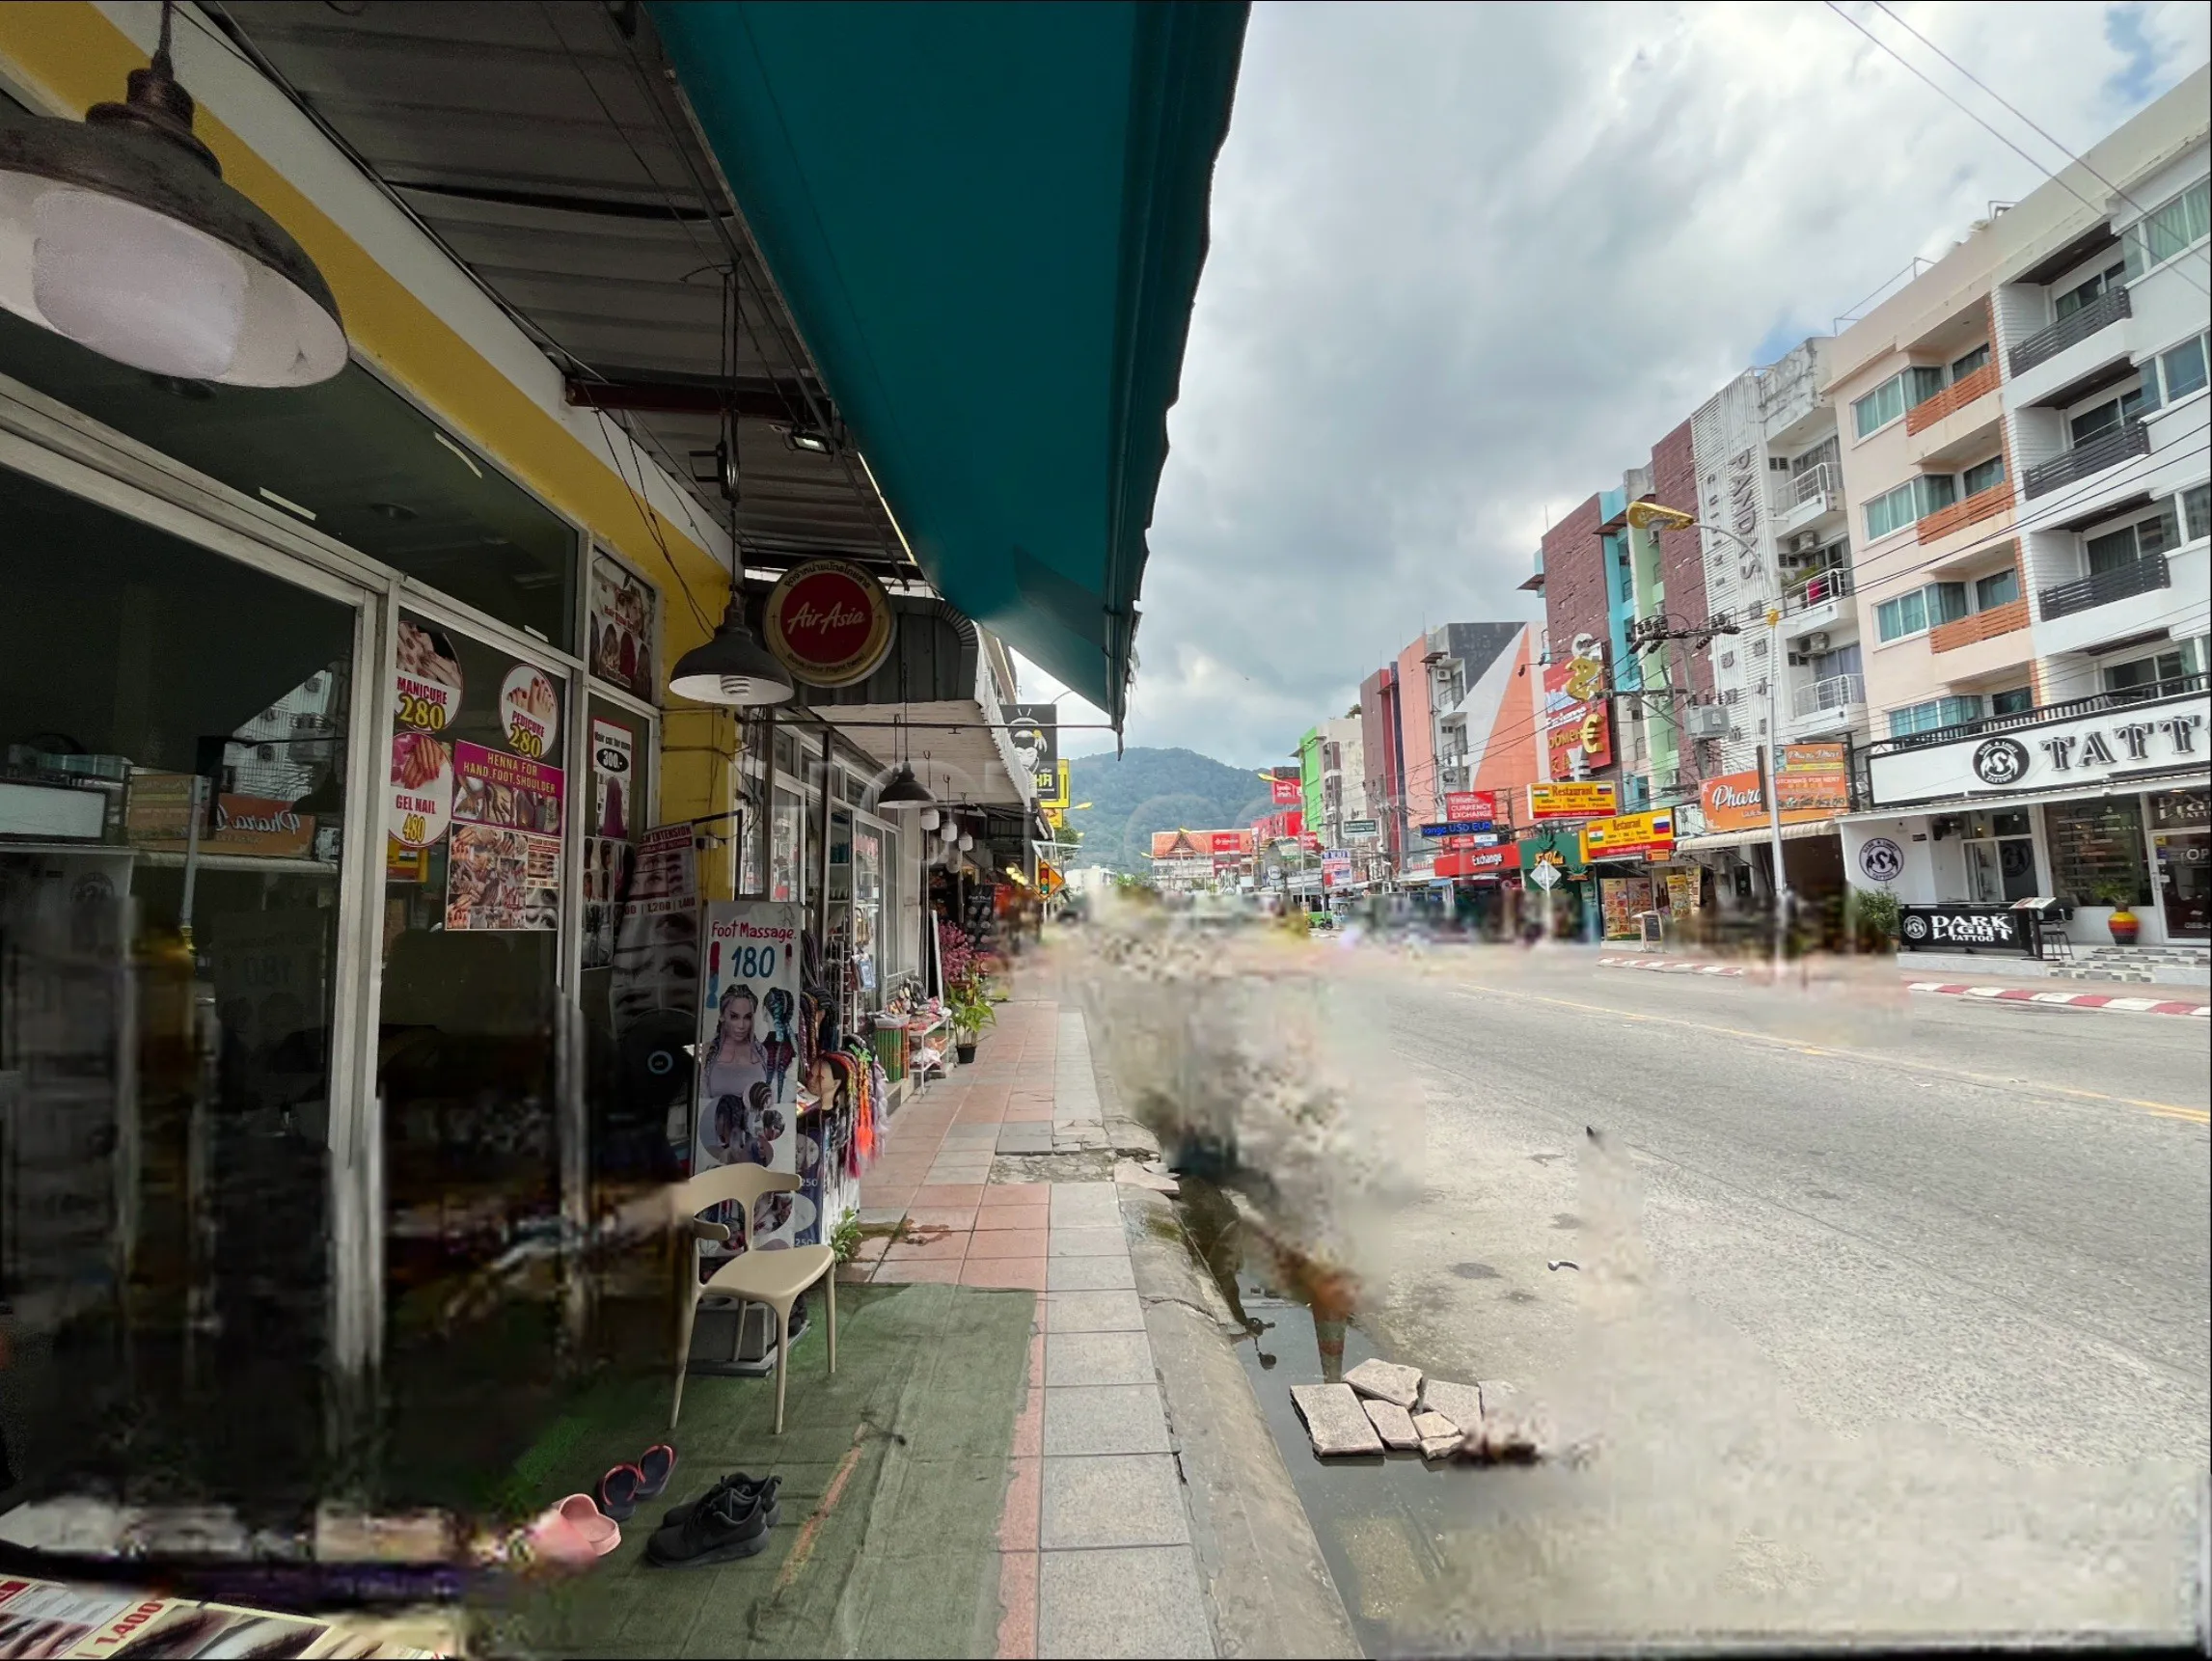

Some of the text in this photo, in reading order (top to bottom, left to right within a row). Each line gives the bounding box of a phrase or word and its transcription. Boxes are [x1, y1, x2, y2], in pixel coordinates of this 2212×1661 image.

[397, 676, 448, 705] MANICURE
[397, 693, 447, 730] 280
[512, 710, 545, 738] PEDICURE
[509, 724, 542, 761] 280
[2039, 715, 2211, 773] TATT
[487, 752, 537, 776] HENNA FOR
[1551, 785, 1594, 797] Restaurant
[396, 795, 437, 814] GEL NAIL
[1451, 803, 1492, 812] CURRENCY
[1452, 810, 1493, 819] EXCHANGE
[402, 812, 426, 843] 480
[1449, 824, 1470, 832] USD
[1472, 822, 1491, 830] EUR
[1471, 854, 1503, 865] Exchange
[647, 902, 671, 912] 1,200
[711, 920, 739, 938] Foot
[1930, 915, 2009, 929] DARK
[1932, 925, 2013, 941] LIGHT
[1952, 934, 1995, 942] TATTOO
[731, 945, 776, 978] 180
[95, 1601, 164, 1647] 1,400
